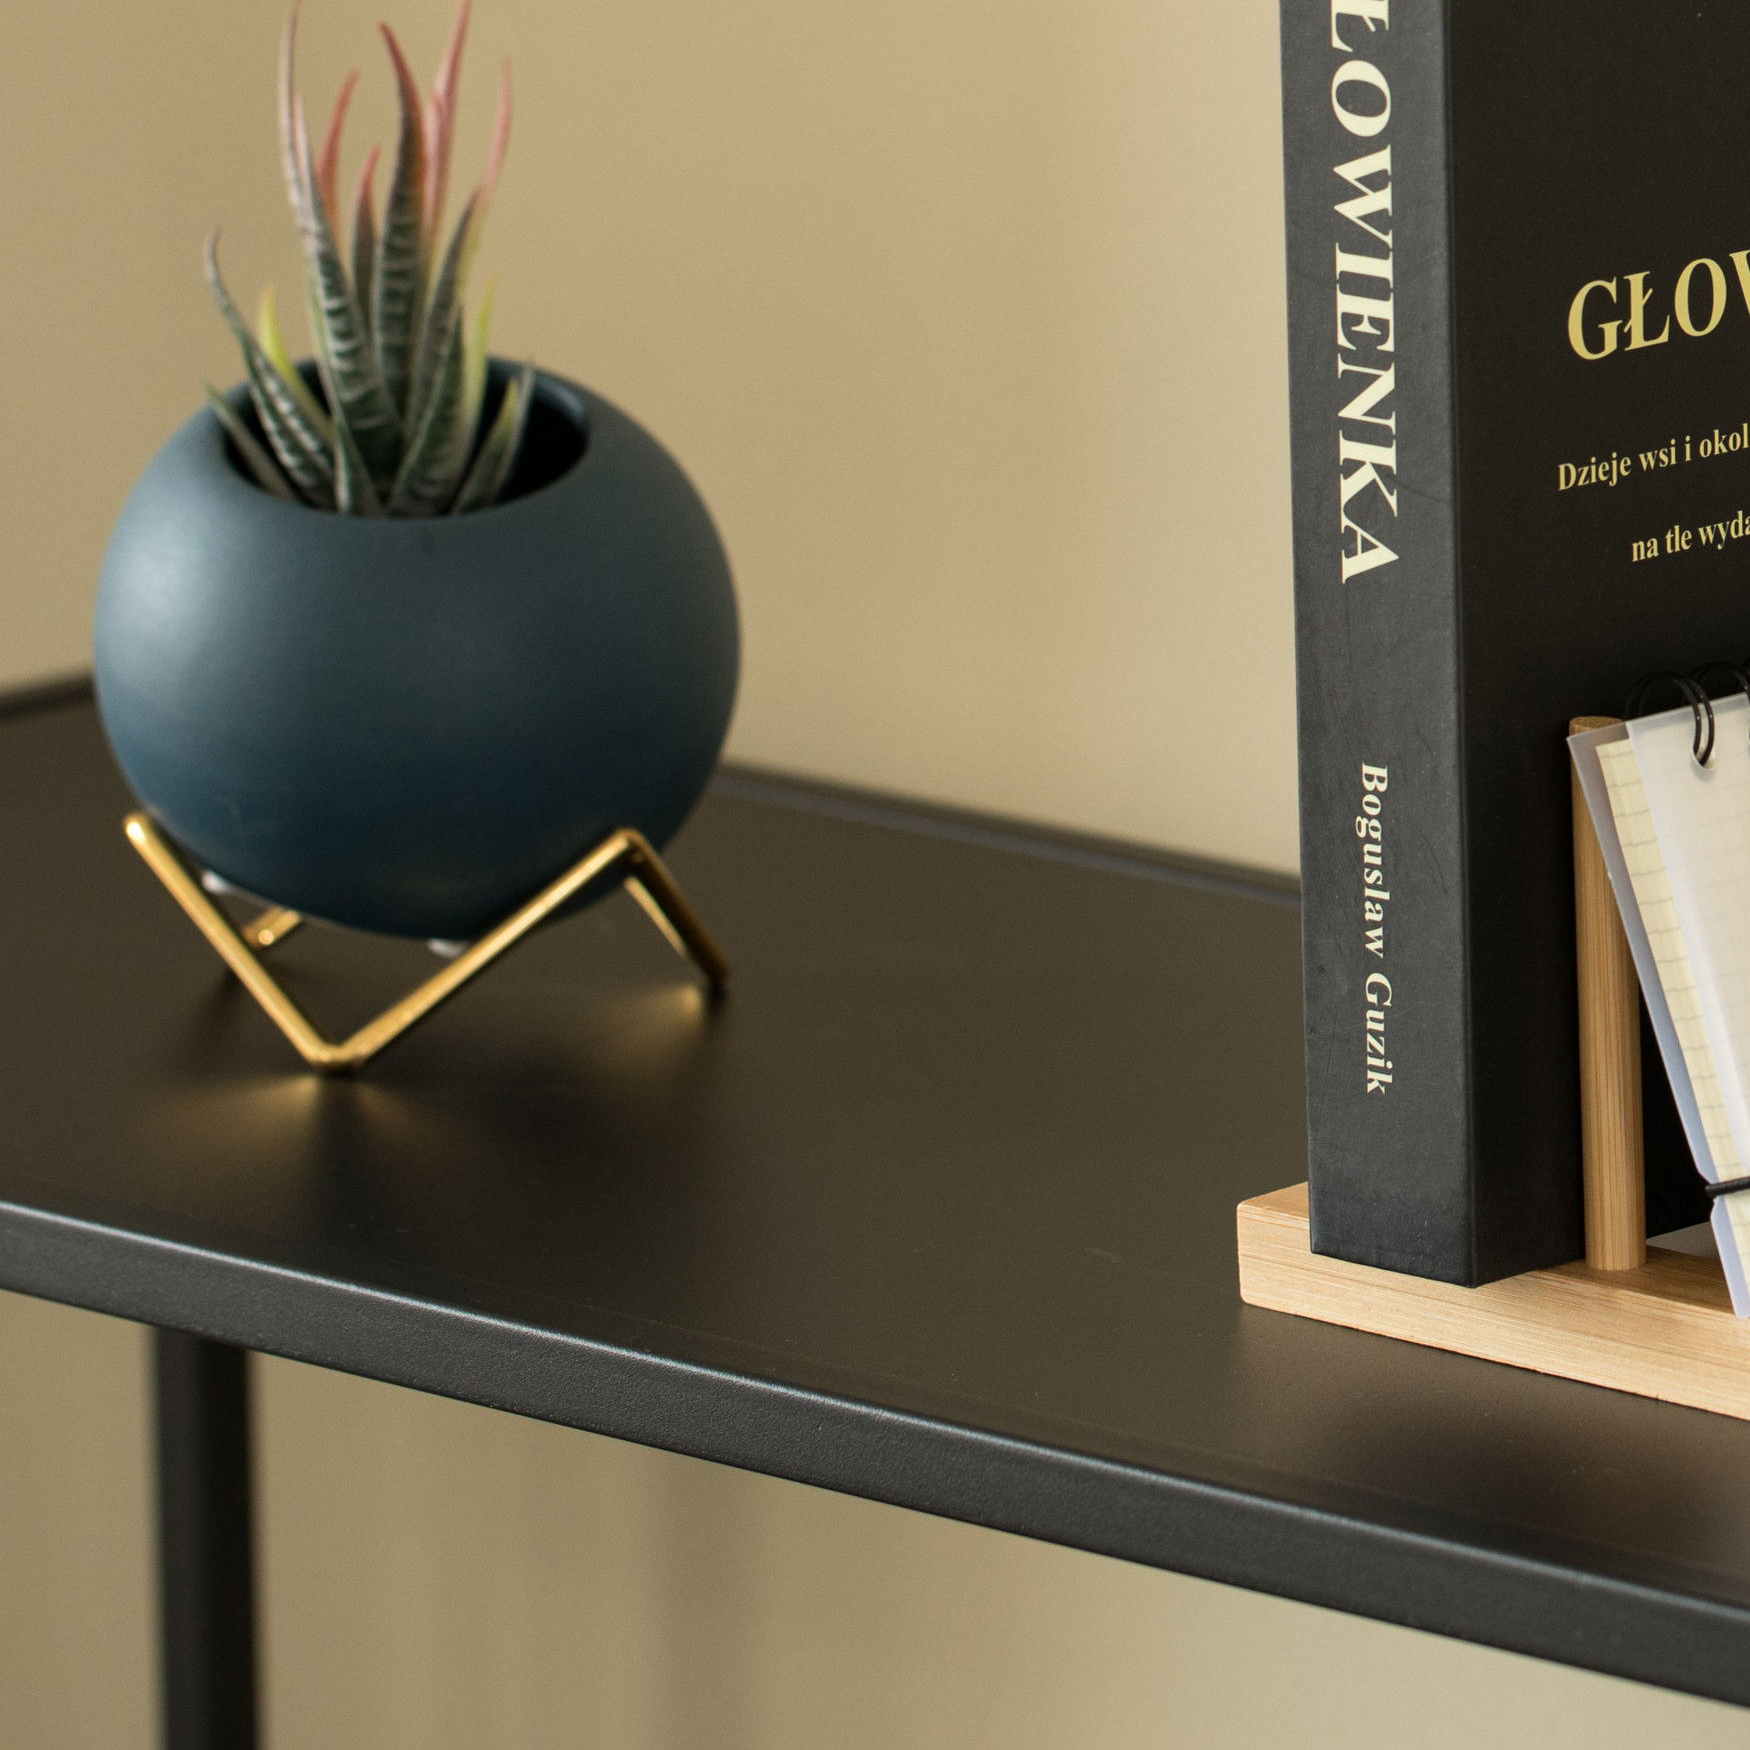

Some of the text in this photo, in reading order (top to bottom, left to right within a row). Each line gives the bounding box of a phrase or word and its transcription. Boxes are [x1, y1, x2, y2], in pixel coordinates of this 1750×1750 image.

[1557, 451, 1632, 492] Dzieje
[1638, 438, 1678, 472] wsi
[1684, 435, 1692, 463] i
[1631, 537, 1660, 564] na
[1665, 523, 1693, 555] tle
[1355, 761, 1393, 1095] Boguslaw Guzik
